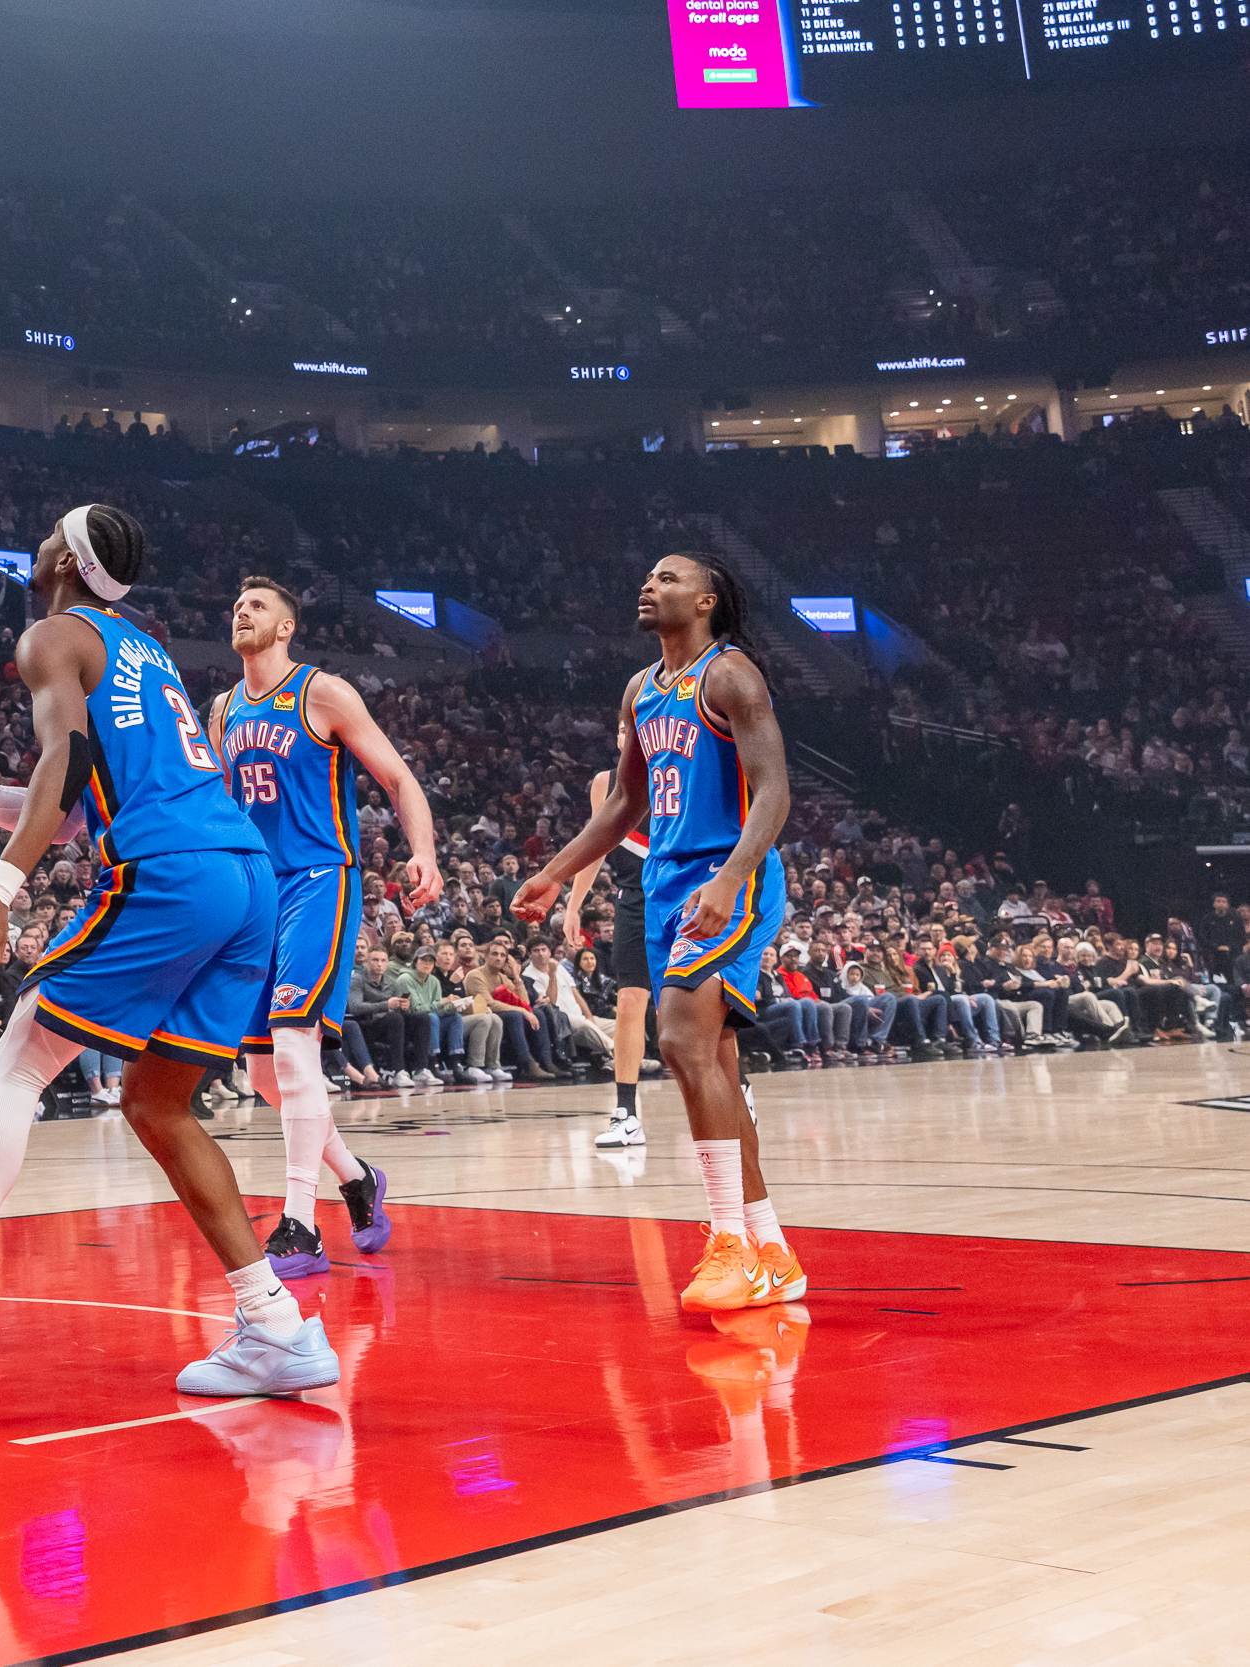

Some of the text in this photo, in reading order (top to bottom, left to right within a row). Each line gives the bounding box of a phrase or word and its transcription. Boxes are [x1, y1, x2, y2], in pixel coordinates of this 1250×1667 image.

[686, 0, 760, 11] dental plans
[801, 7, 810, 17] 11
[812, 7, 831, 16] JOE
[1042, 0, 1098, 12] 21 RUPERT
[688, 12, 760, 25] for all ages
[801, 20, 811, 29] 13
[813, 19, 844, 28] DIENG
[1042, 16, 1056, 25] 26
[1058, 11, 1094, 23] REATH
[802, 32, 813, 41] 15
[815, 30, 861, 40] CARLSON
[1044, 27, 1058, 37] 35
[1059, 21, 1115, 36] WILLIAMS
[1116, 19, 1130, 30] III
[802, 44, 814, 54] 23
[816, 41, 874, 53] BARNHIZER
[1048, 40, 1060, 50] 91
[1061, 34, 1110, 48] CISSOKO
[709, 43, 747, 57] moda
[1205, 327, 1250, 345] SHIF
[293, 361, 368, 376] www.shift4.com
[876, 356, 966, 371] www.shift4.com
[162, 683, 222, 772] 2
[224, 719, 298, 765] THUNDER
[638, 715, 700, 764] HUNDER
[236, 761, 280, 805] 55
[652, 764, 682, 817] 22
